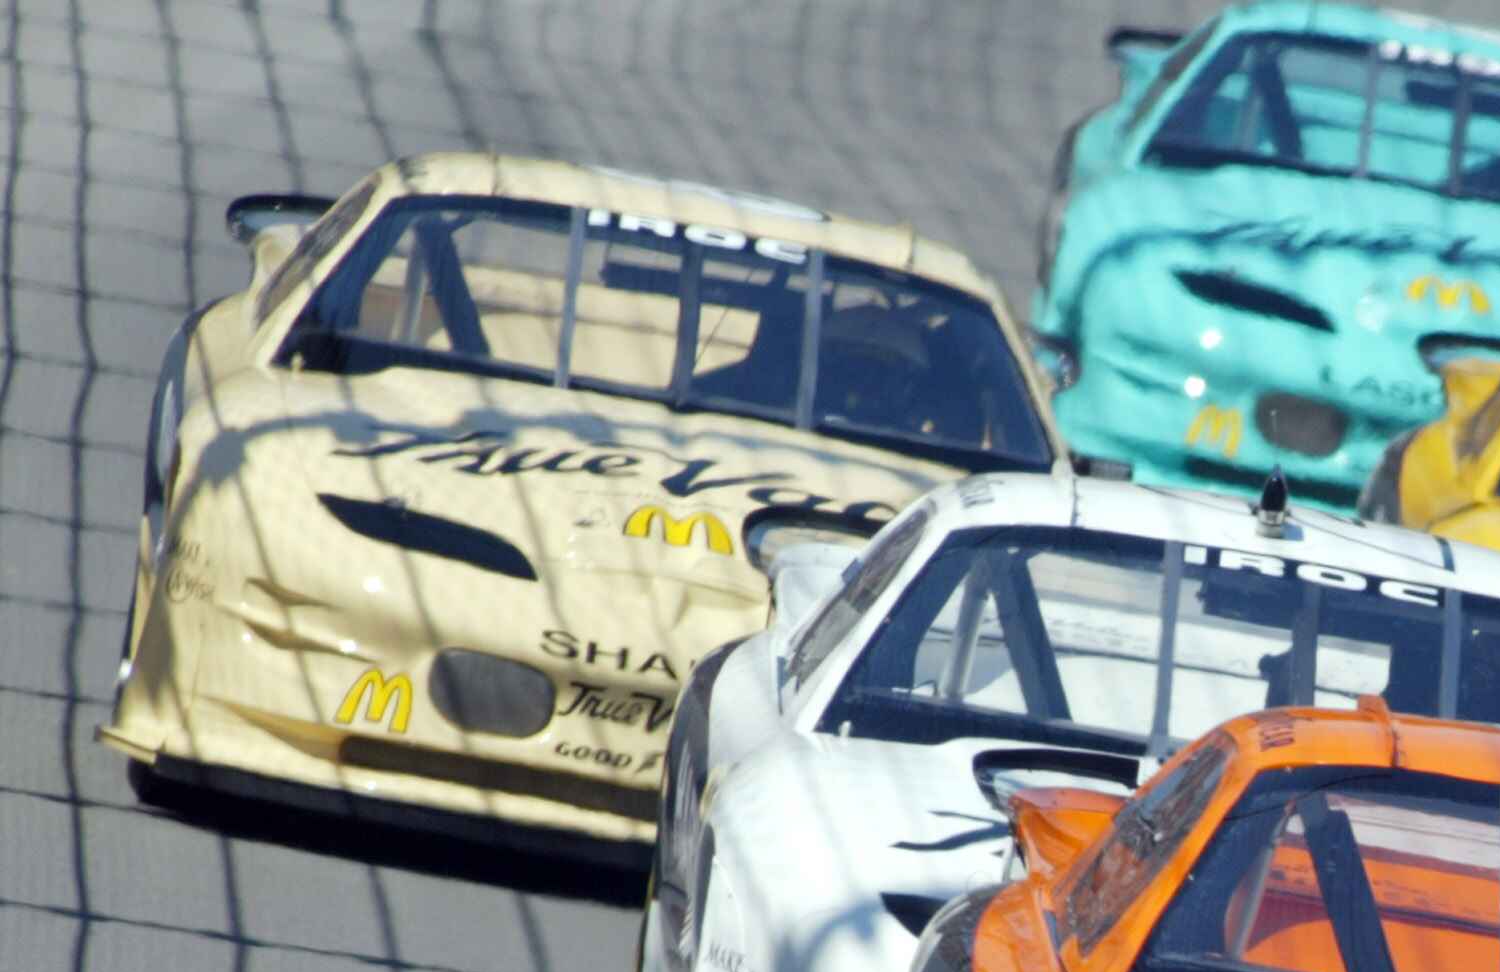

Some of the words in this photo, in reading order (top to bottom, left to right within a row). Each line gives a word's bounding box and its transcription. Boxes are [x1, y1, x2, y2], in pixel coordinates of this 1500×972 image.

[587, 207, 809, 265] IROC
[1183, 545, 1439, 608] IROC
[540, 629, 697, 680] SHA
